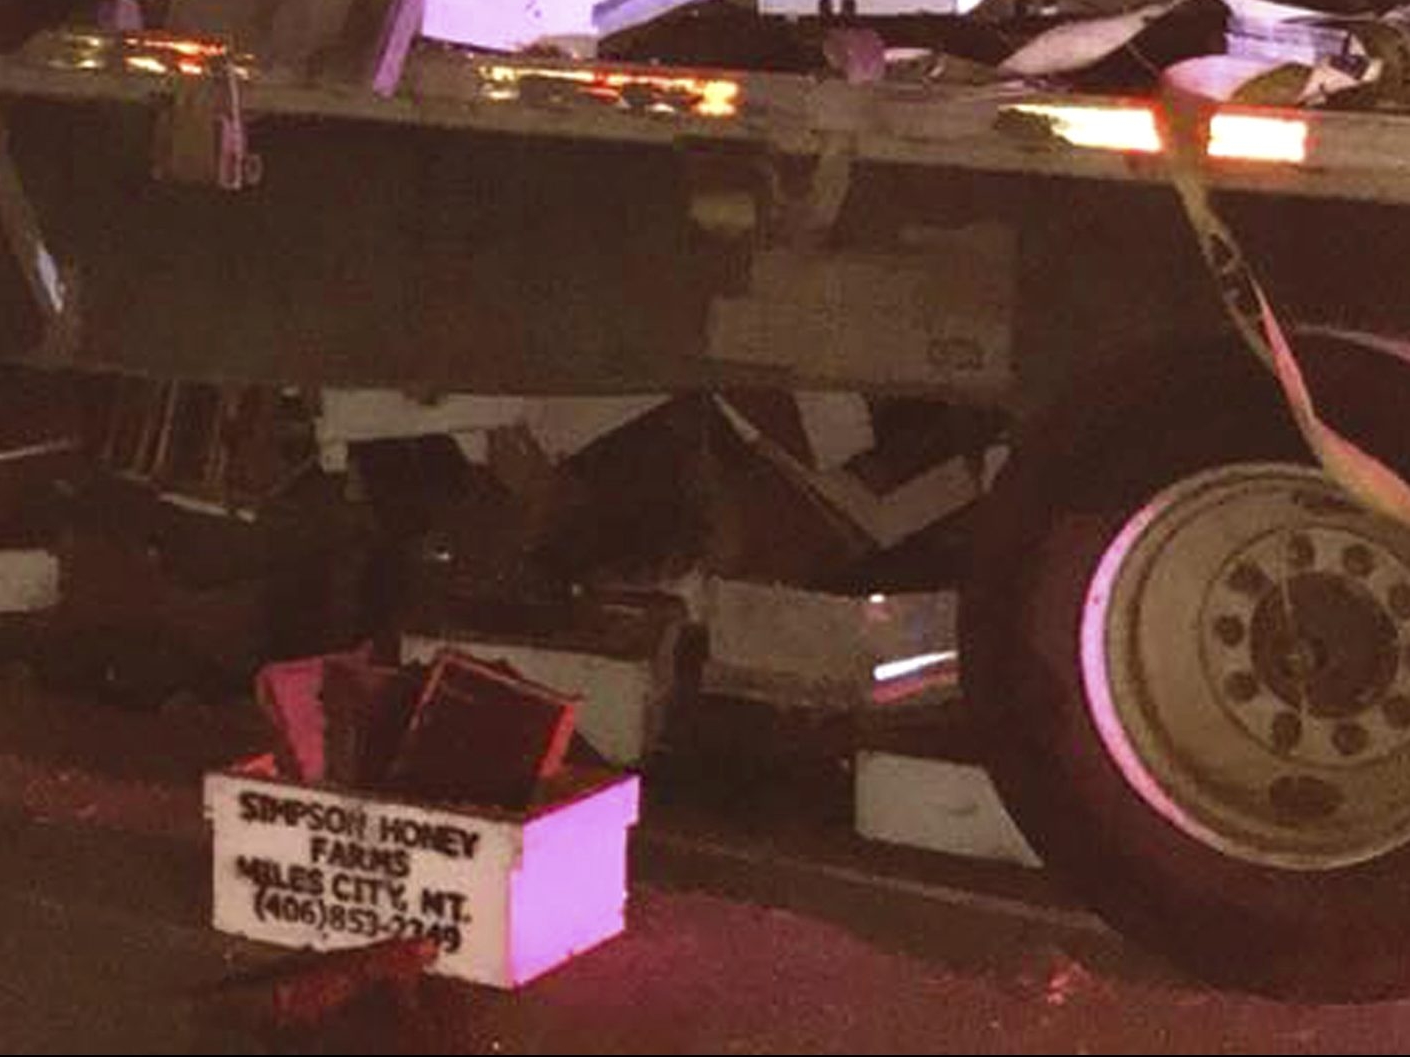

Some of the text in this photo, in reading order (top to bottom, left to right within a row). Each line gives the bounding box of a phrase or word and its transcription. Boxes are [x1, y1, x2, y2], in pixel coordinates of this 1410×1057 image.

[238, 790, 482, 860] SIMPSON HONEY
[235, 853, 325, 895] MILES
[309, 835, 411, 879] FARMS
